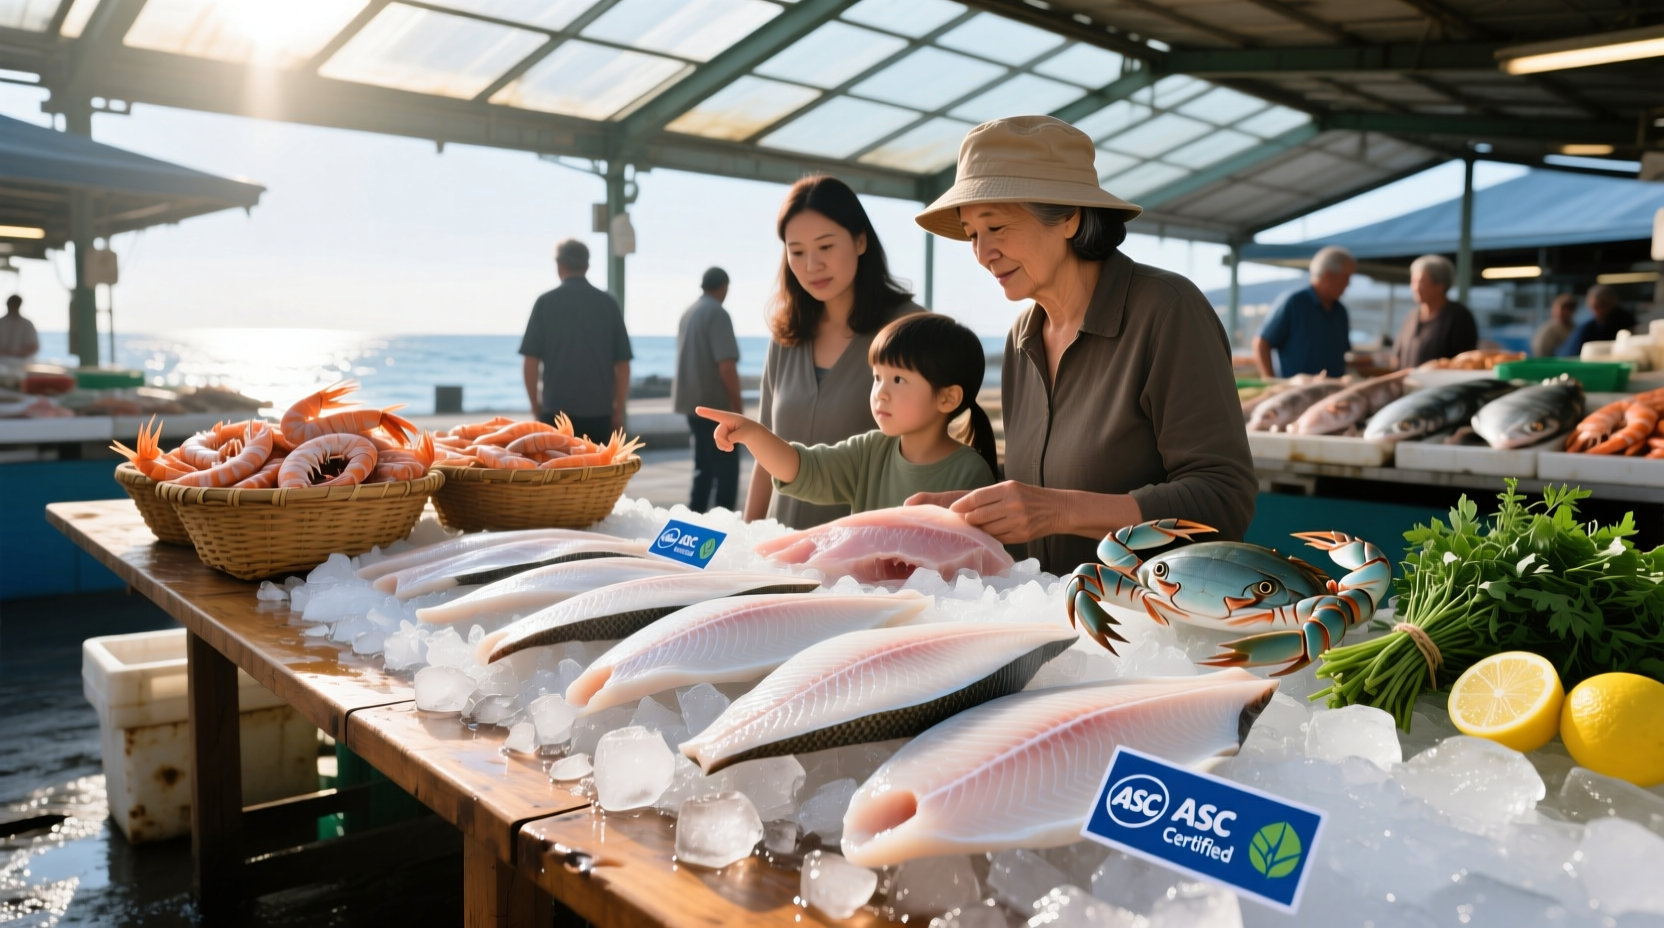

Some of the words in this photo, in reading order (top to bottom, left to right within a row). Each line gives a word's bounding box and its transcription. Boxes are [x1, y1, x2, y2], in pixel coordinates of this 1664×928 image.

[1111, 786, 1163, 817] ASC
[1171, 798, 1237, 837] ASC
[1162, 827, 1234, 864] Certified
